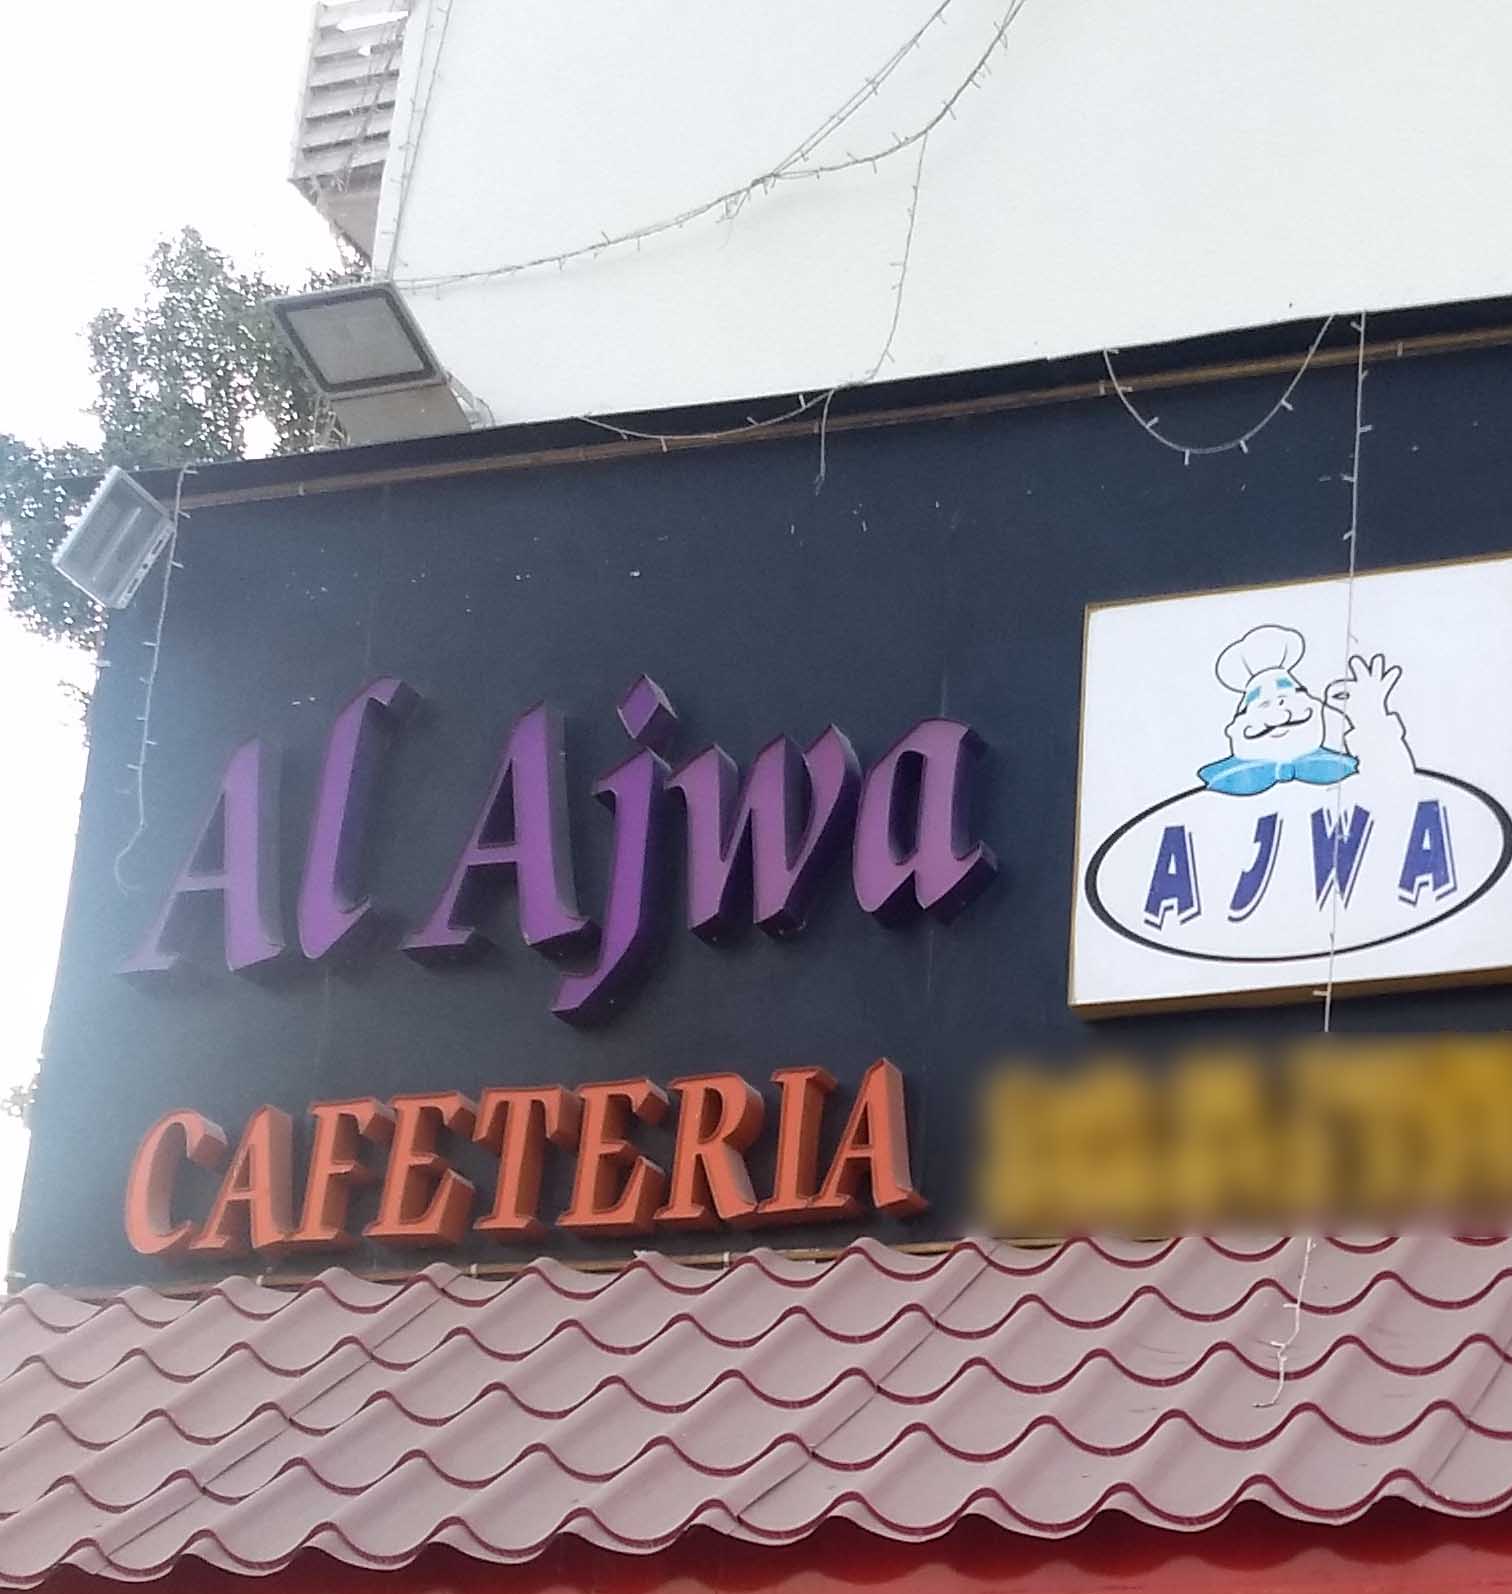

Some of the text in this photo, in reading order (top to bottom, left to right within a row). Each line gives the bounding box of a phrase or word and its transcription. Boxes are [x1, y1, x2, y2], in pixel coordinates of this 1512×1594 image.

[120, 672, 998, 1024] Al Ajwa
[1143, 798, 1458, 931] AJWA
[124, 1056, 927, 1258] CAFETERIA
